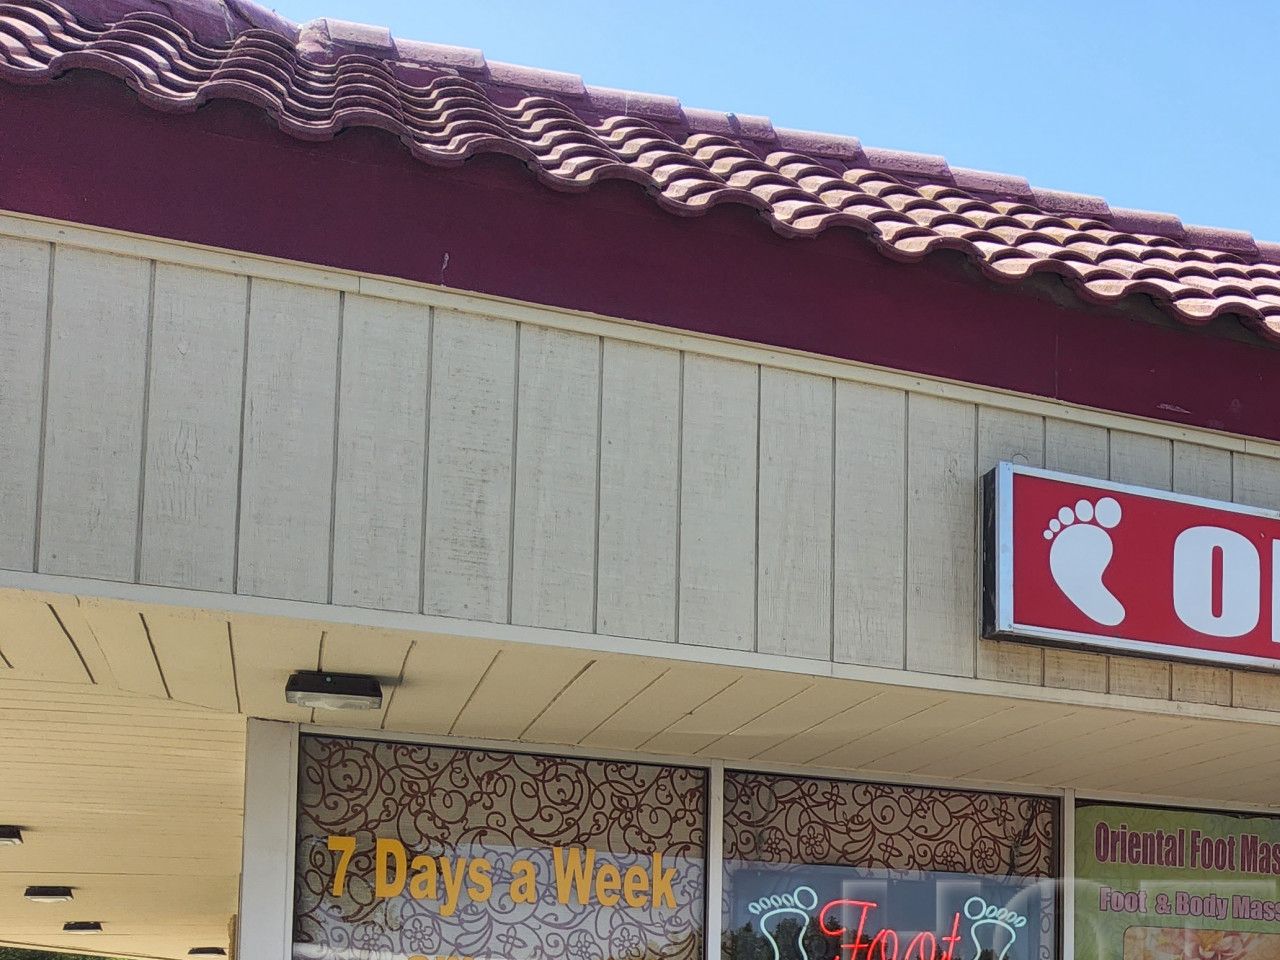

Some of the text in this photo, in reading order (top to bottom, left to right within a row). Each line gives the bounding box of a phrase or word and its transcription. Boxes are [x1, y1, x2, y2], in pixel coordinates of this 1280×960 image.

[1095, 821, 1185, 868] Oriental
[1190, 828, 1236, 871] Foot
[327, 836, 676, 916] 7 Days a Week
[1099, 886, 1147, 913] Foot
[1155, 893, 1172, 915] &
[1175, 890, 1229, 920] Body
